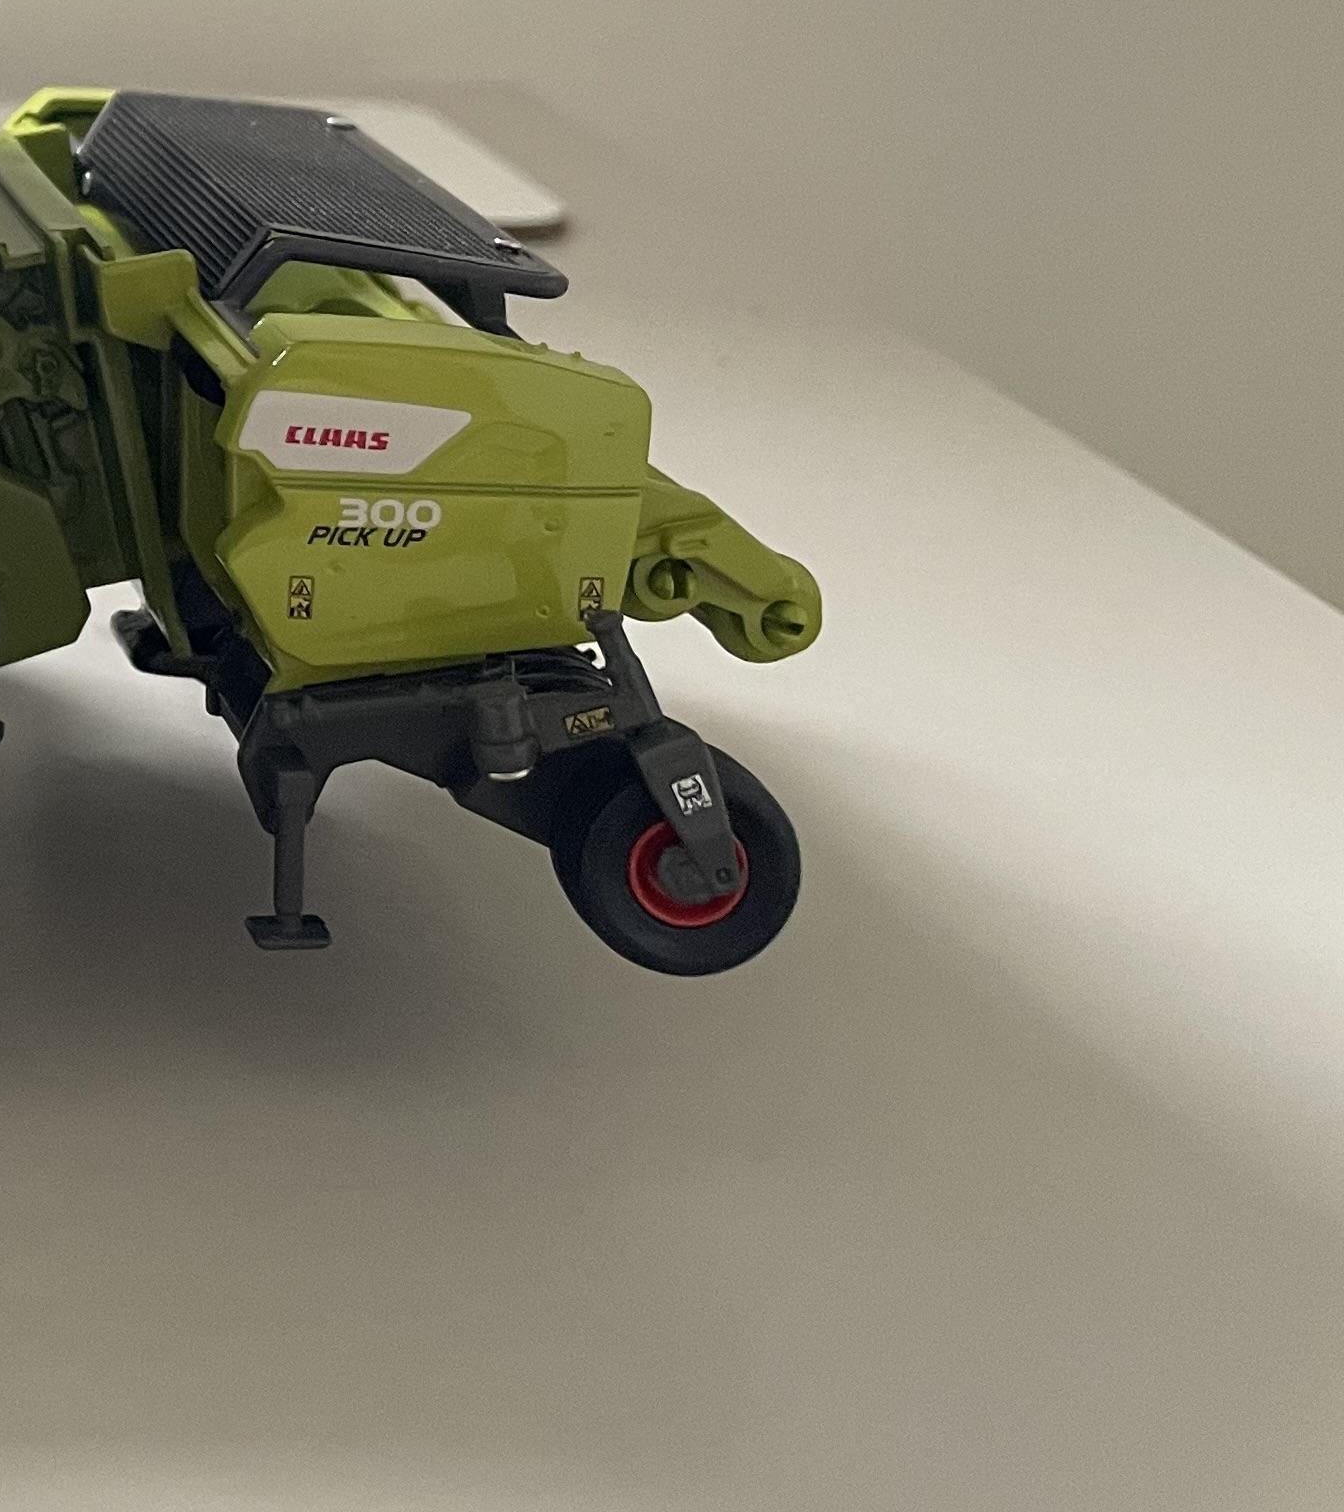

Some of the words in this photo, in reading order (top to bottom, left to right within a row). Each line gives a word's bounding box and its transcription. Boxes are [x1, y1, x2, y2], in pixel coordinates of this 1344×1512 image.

[285, 426, 390, 450] CLAAS
[339, 498, 442, 528] 300
[307, 526, 374, 547] PICK
[383, 527, 427, 548] UP
